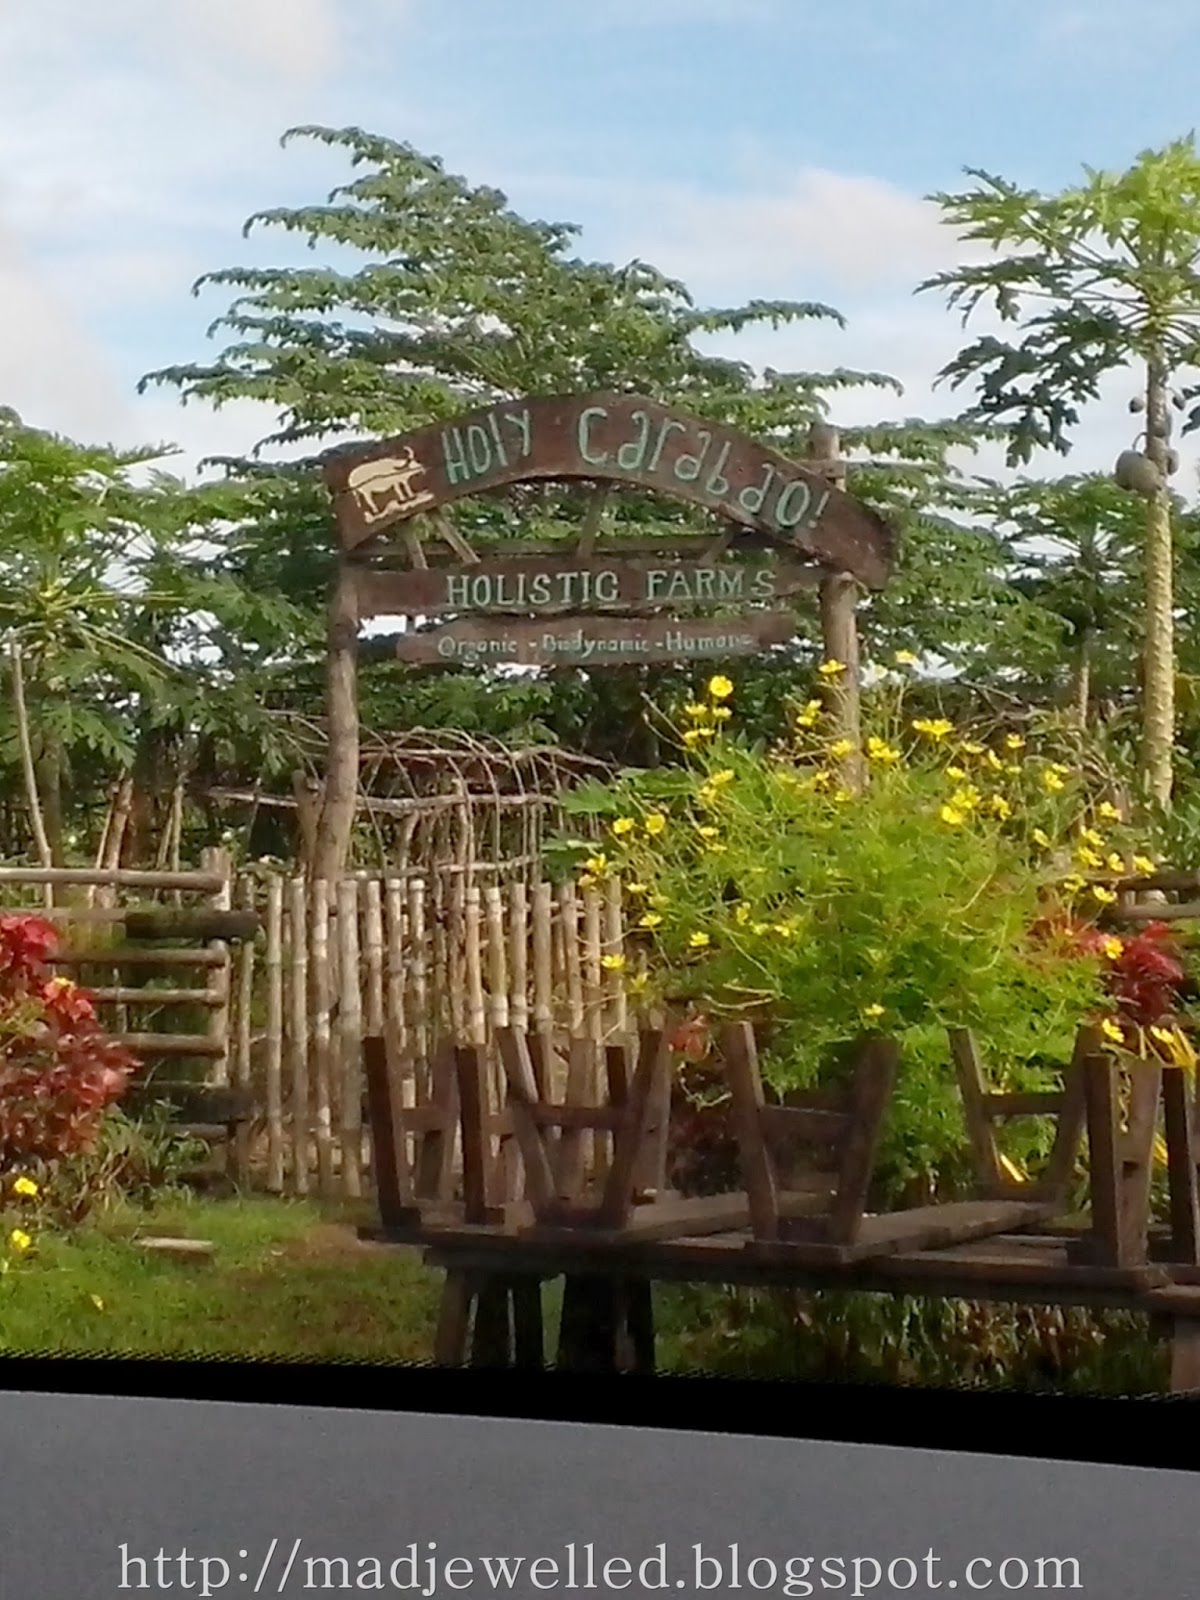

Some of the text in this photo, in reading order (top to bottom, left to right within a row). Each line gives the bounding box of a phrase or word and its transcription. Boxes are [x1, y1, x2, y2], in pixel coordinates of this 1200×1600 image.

[446, 569, 777, 608] HOLISTIC FARMS
[437, 634, 518, 662] Organic
